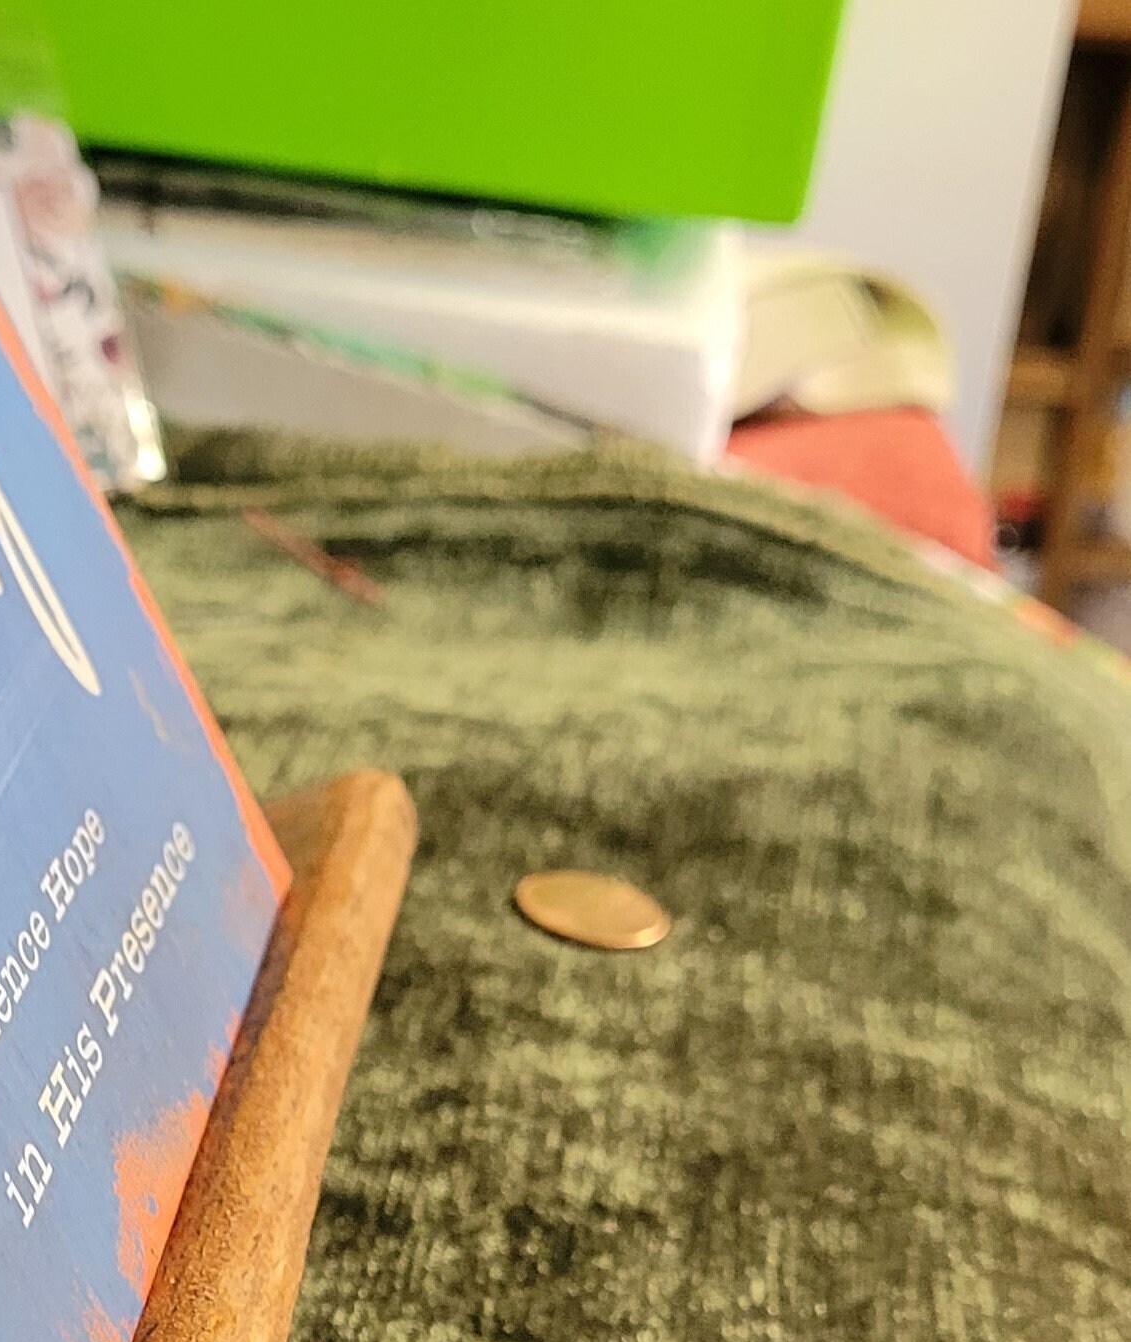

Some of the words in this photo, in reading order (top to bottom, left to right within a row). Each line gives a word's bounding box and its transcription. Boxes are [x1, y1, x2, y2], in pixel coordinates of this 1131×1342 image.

[40, 808, 106, 922] Hope
[3, 1142, 54, 1229] in
[38, 1023, 103, 1149] His
[89, 821, 196, 1037] Presence
